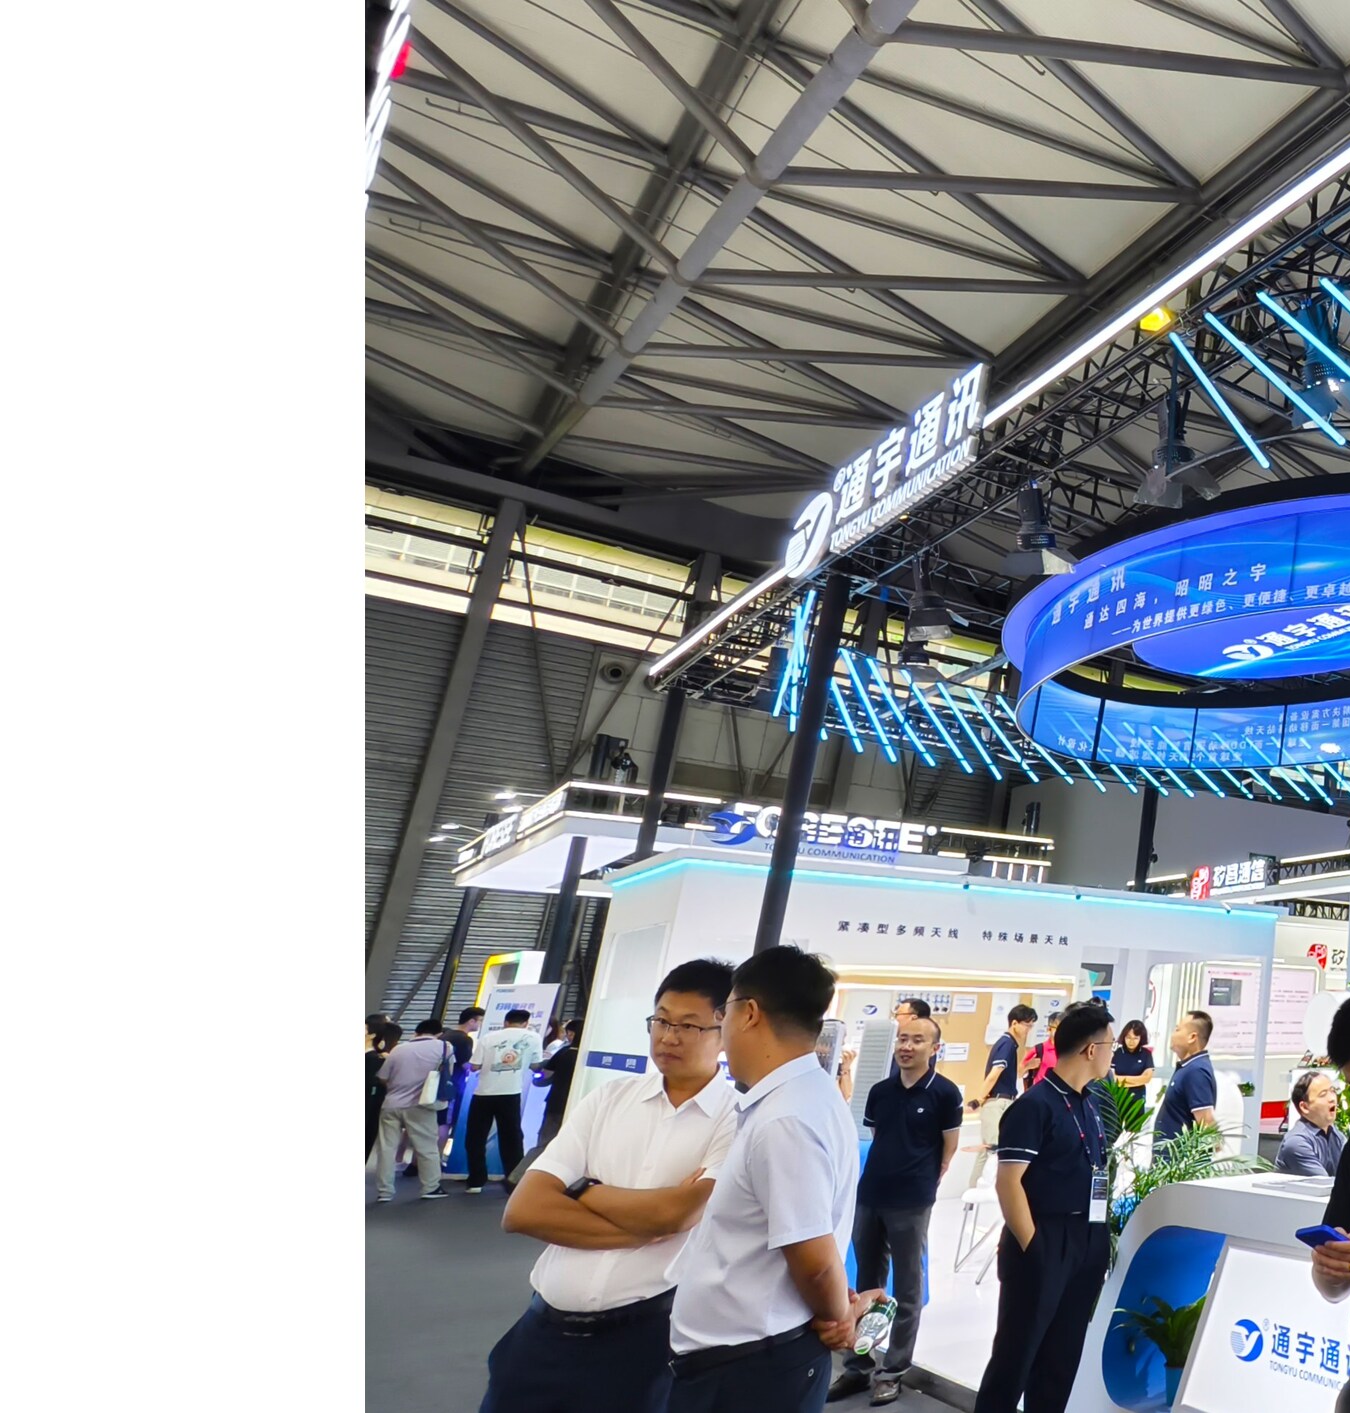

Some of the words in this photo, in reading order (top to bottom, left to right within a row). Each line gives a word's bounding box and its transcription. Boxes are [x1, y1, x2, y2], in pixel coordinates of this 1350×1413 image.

[835, 363, 984, 525] 通宇通讯
[829, 508, 872, 549] TONGYU
[870, 439, 970, 522] COMMUNICATION
[1051, 565, 1126, 626] 通宇通讯
[764, 842, 805, 857] TOU
[806, 847, 896, 863] COMMUNICATION
[837, 920, 959, 940] 紧凑型多频天线
[982, 930, 1069, 946] 特殊场景天线
[1269, 1360, 1297, 1377] TONGYU
[1299, 1369, 1344, 1391] COMMUNIC
